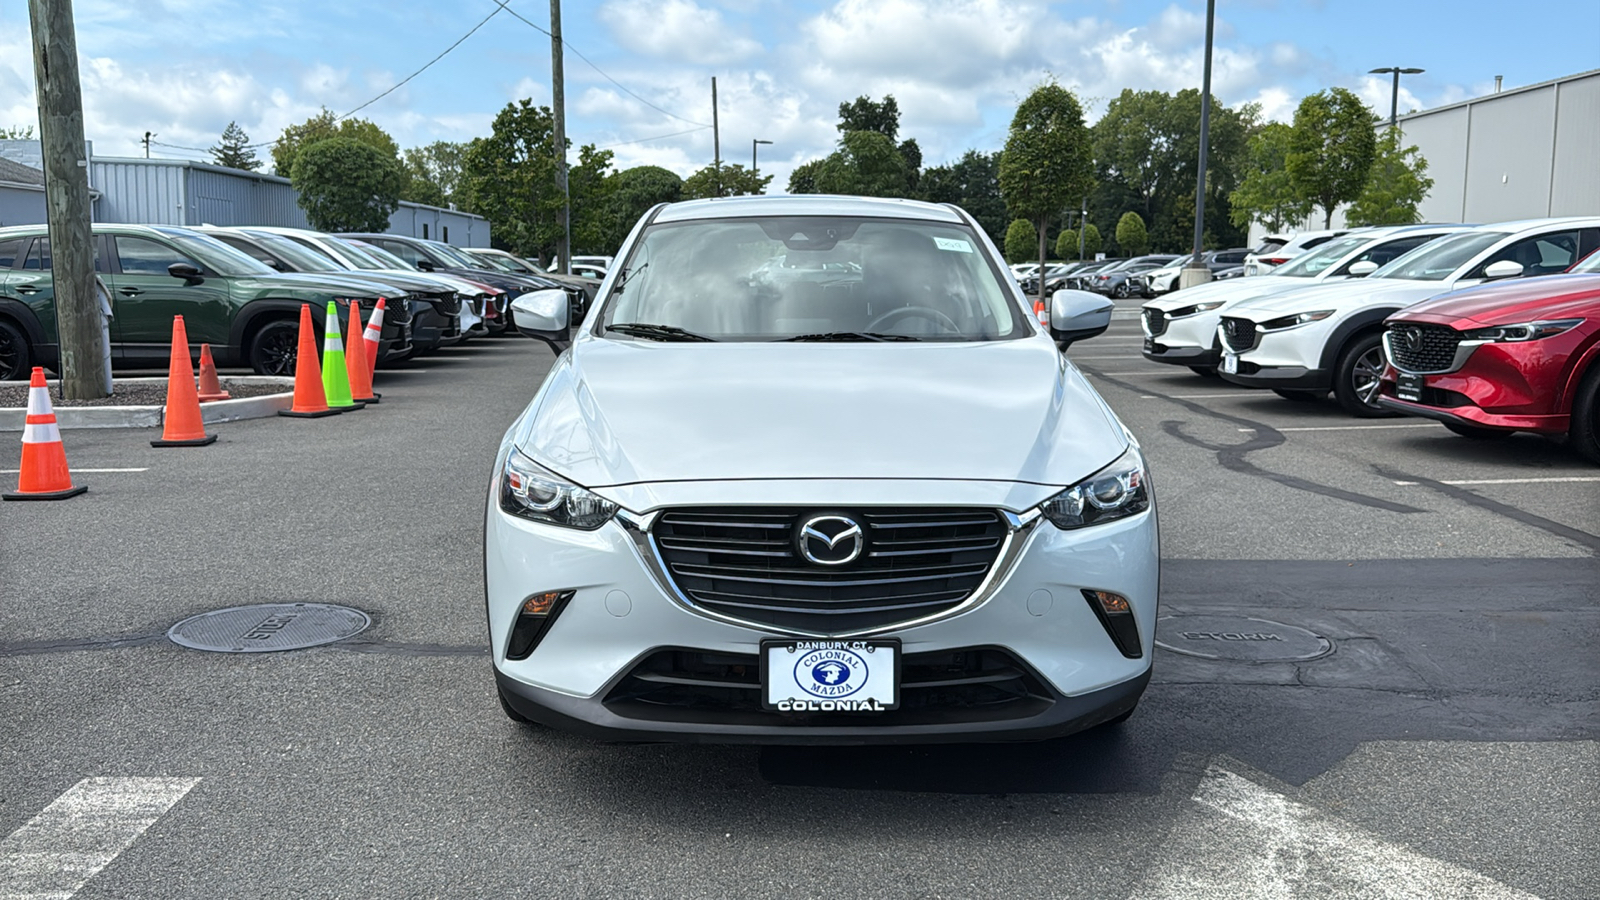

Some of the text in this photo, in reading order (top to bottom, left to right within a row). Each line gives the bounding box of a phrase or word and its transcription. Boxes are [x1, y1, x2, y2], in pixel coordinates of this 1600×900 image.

[1179, 631, 1283, 642] STORM
[853, 641, 867, 649] CT
[803, 651, 860, 669] COLONIAL
[810, 682, 853, 695] MAZDA
[777, 700, 885, 711] COLONIAL
